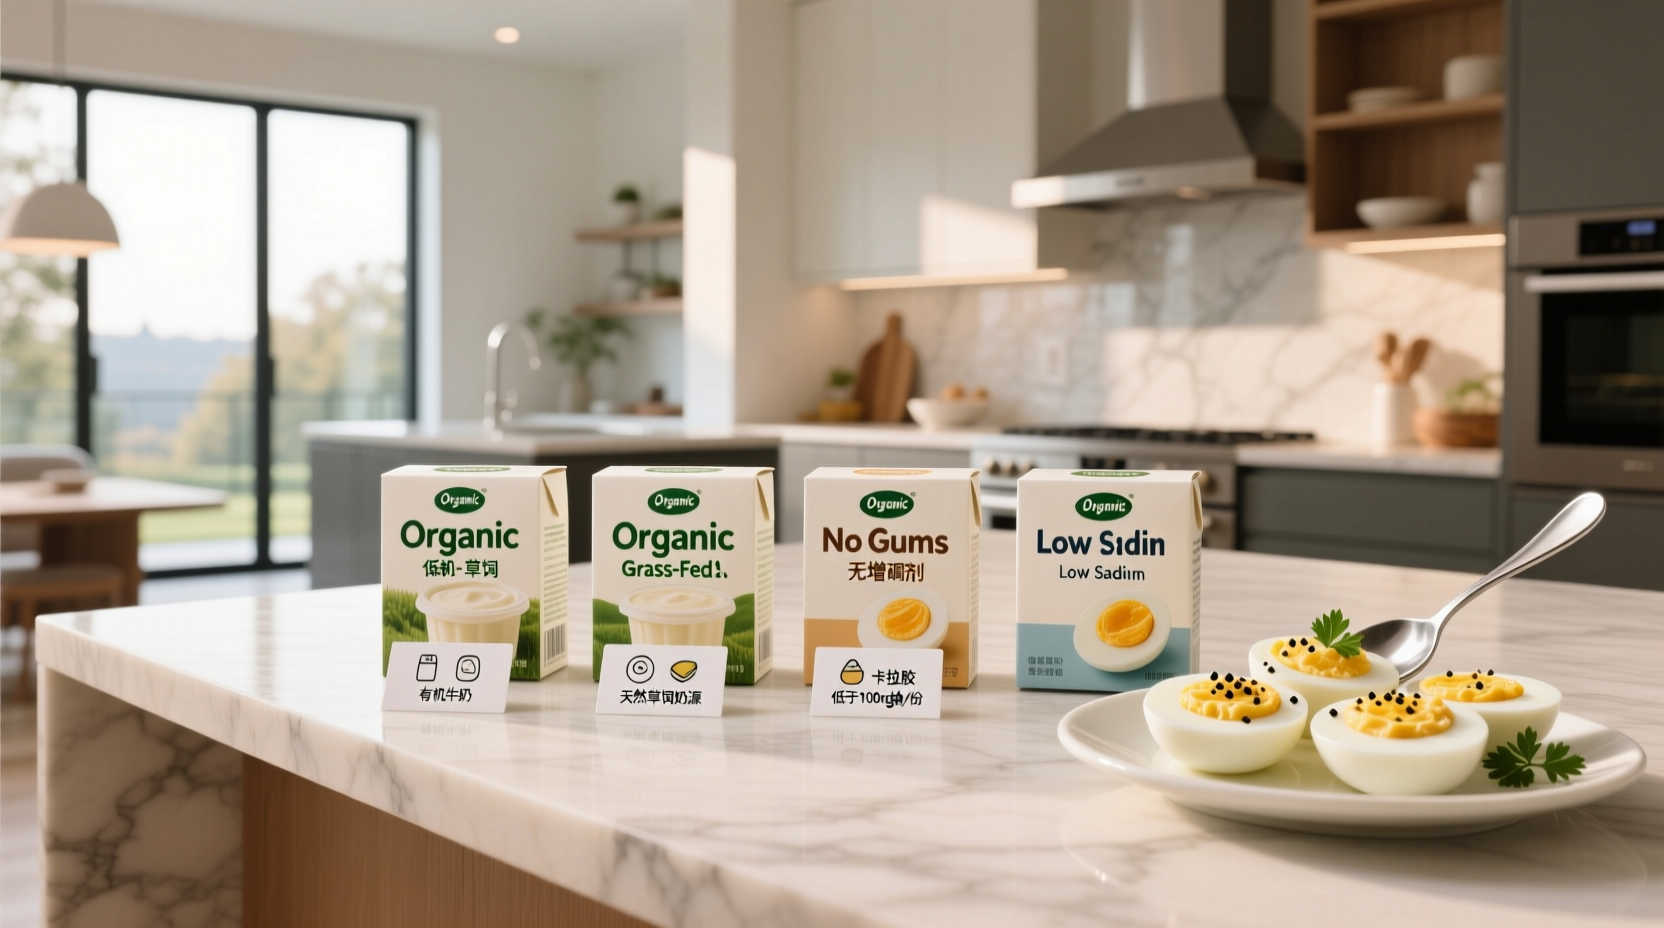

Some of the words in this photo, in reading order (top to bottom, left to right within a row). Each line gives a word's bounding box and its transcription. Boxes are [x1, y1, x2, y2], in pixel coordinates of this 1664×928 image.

[440, 492, 480, 509] Organic
[400, 519, 520, 557] Organic
[612, 521, 735, 559] Organic
[823, 527, 862, 553] No
[868, 527, 949, 554] Gums
[1037, 528, 1093, 555] Low
[1059, 564, 1090, 580] Low
[871, 668, 917, 686] 卡拉胶
[418, 686, 473, 703] 有机牛奶
